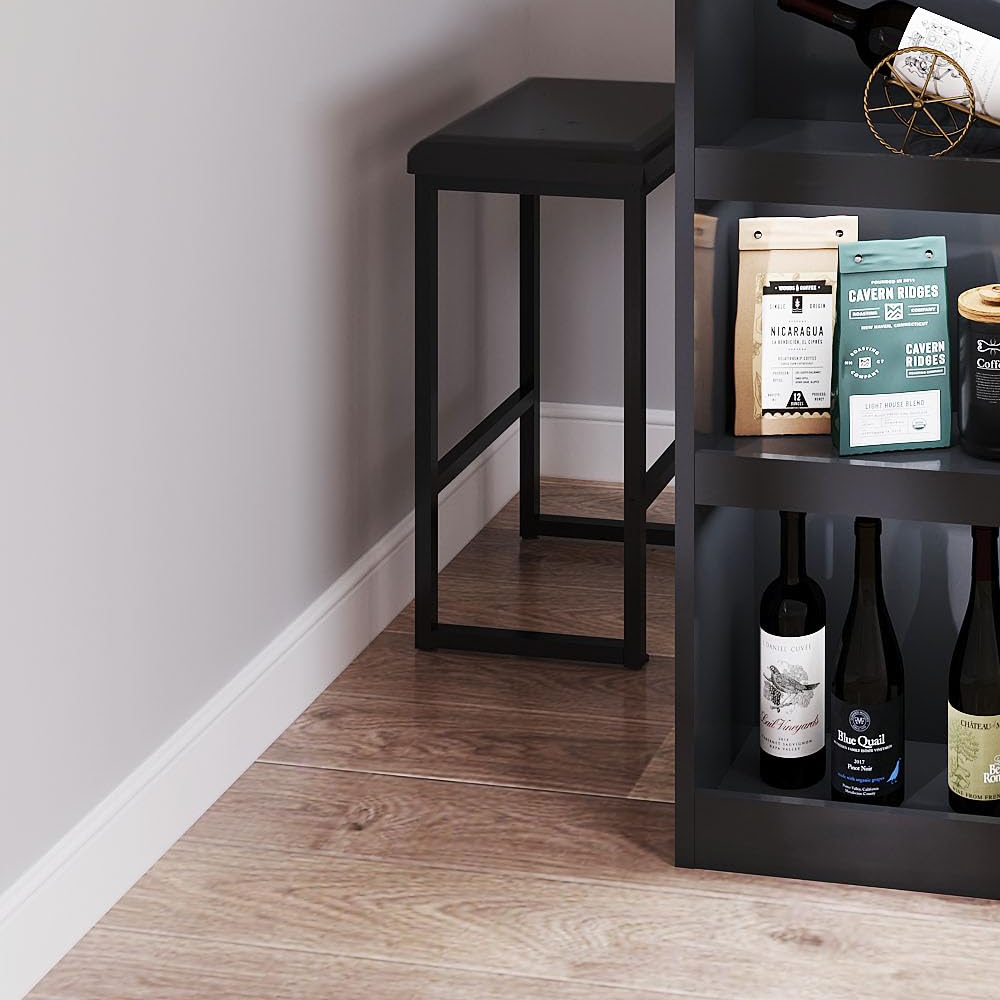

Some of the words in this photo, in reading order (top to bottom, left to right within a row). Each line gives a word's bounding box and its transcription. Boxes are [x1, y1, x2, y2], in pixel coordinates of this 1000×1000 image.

[848, 287, 894, 303] CAVERN
[897, 285, 939, 300] RIDGES
[770, 326, 824, 337] NICARAGUA
[849, 346, 880, 357] ROASTING
[905, 341, 945, 355] CAVERN
[905, 354, 946, 367] RIDGES
[850, 368, 880, 379] COMPANY
[793, 392, 802, 402] 12
[837, 729, 857, 746] Blue
[857, 733, 886, 749] Quail
[965, 792, 983, 800] FROM
